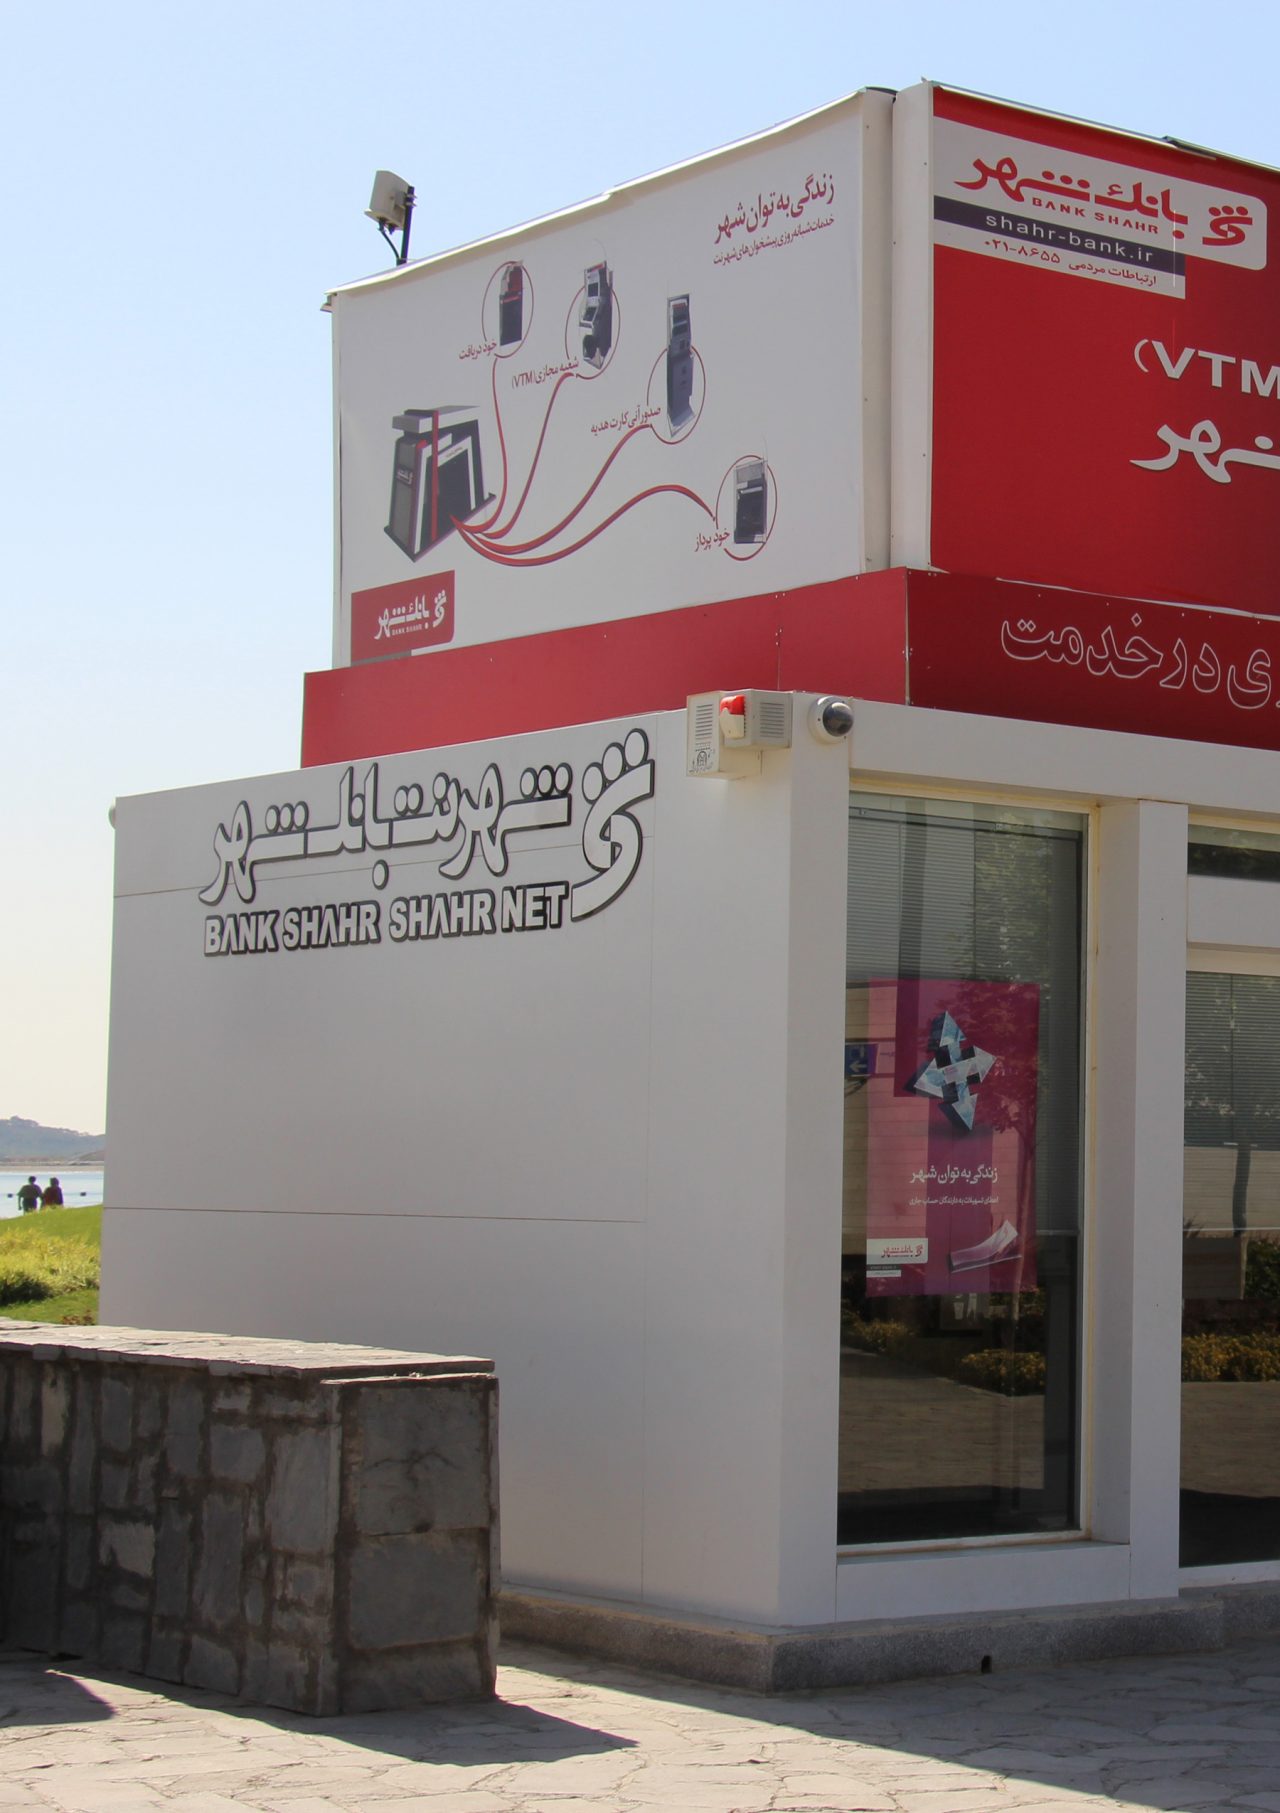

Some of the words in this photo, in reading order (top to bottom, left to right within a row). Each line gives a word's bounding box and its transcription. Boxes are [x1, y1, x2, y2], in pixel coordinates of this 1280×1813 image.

[791, 173, 834, 218] زندگی
[953, 157, 1091, 202] شهر
[714, 202, 745, 244] شهر
[746, 192, 775, 232] توان
[777, 193, 790, 218] به
[1032, 197, 1086, 217] BANK
[1094, 210, 1159, 235] SHAHR
[1094, 182, 1188, 239] بانک
[986, 214, 1155, 263] shahr-bank.ir
[1069, 261, 1106, 275] مردمی
[1108, 266, 1157, 287] ارتباطات
[374, 606, 406, 640] شهر
[1001, 613, 1164, 679] خدمت
[1159, 638, 1221, 693] در
[306, 762, 394, 890] بانک
[198, 800, 308, 904] شهر
[204, 909, 280, 956] BANK
[282, 901, 381, 951] SHAHR
[389, 889, 496, 942] SHAHR
[501, 880, 570, 931] NET
[909, 1164, 937, 1184] شهر
[937, 1163, 960, 1184] توان
[970, 1163, 998, 1184] زندگی
